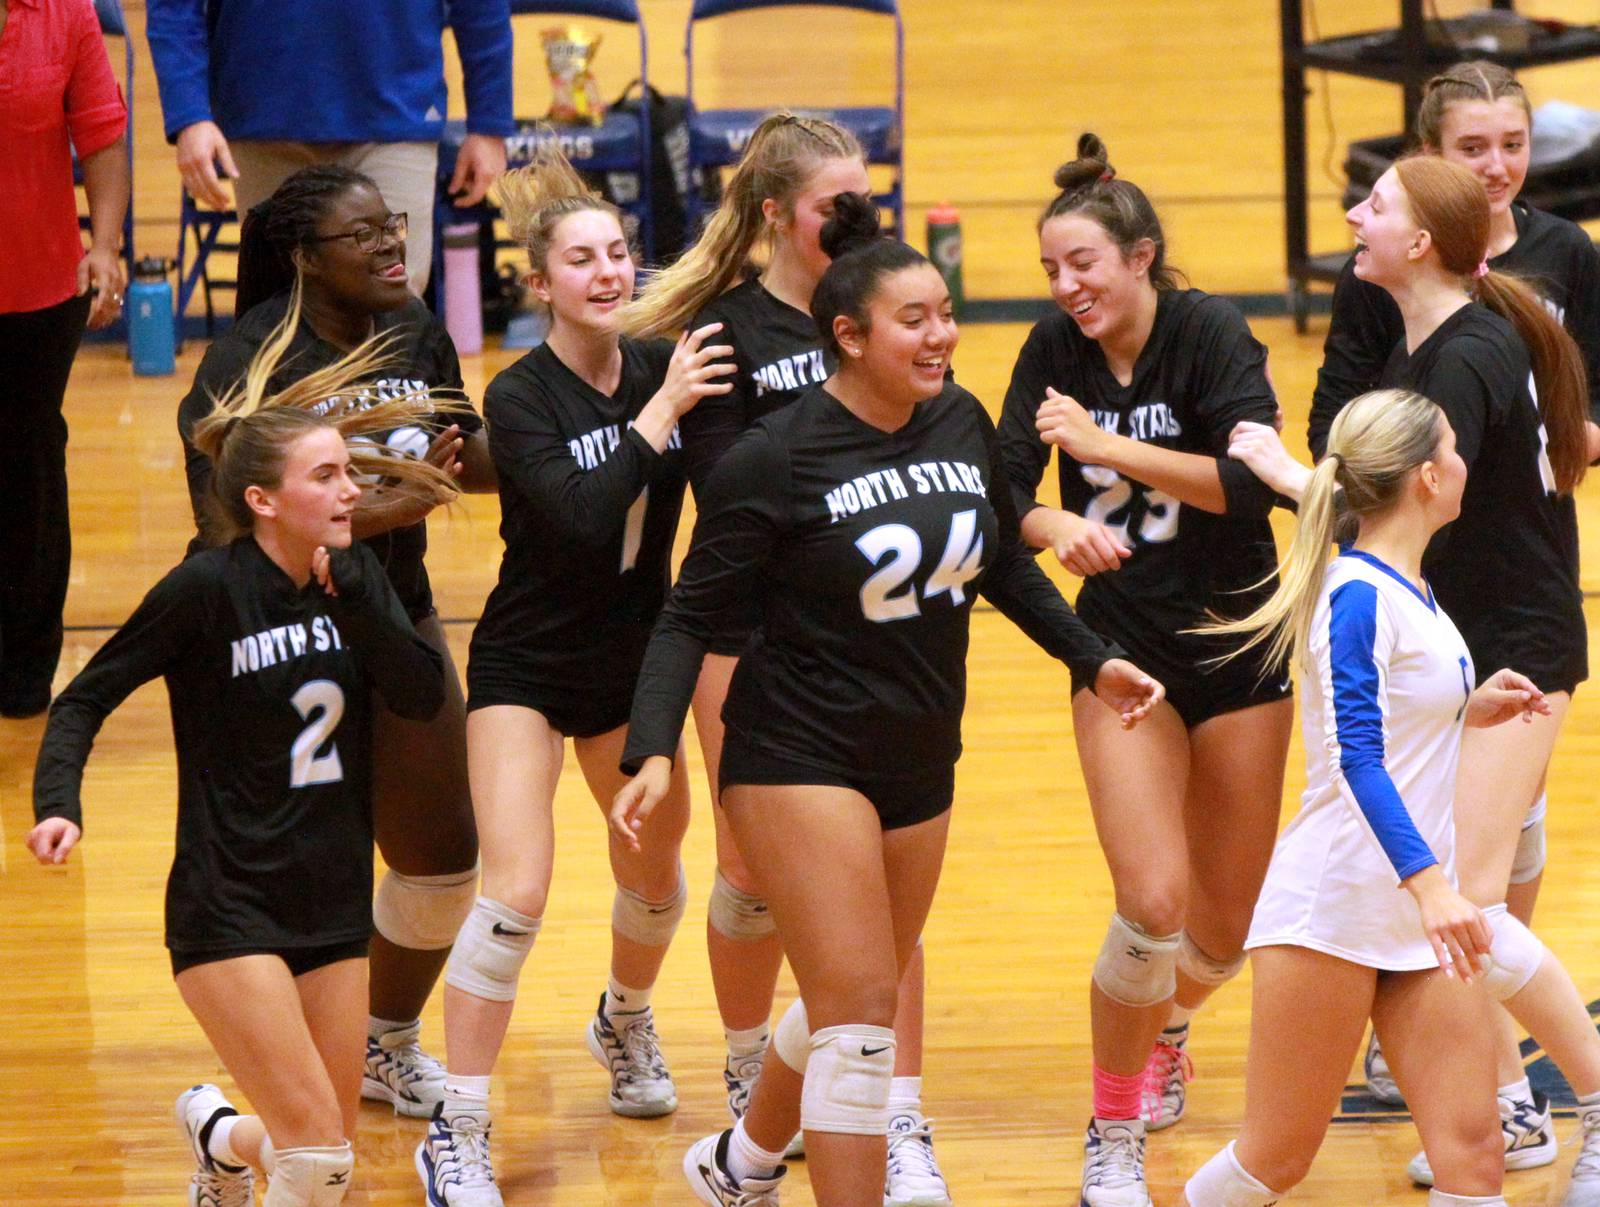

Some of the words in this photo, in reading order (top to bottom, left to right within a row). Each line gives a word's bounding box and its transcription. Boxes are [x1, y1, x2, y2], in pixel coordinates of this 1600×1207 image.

[506, 135, 594, 159] KINGS
[751, 349, 828, 398] NORTH
[567, 424, 621, 471] ORTH
[824, 468, 909, 524] NORTH
[907, 461, 986, 499] STARS
[854, 508, 985, 623] 24
[231, 623, 307, 679] NORTH
[289, 678, 345, 789] 2
